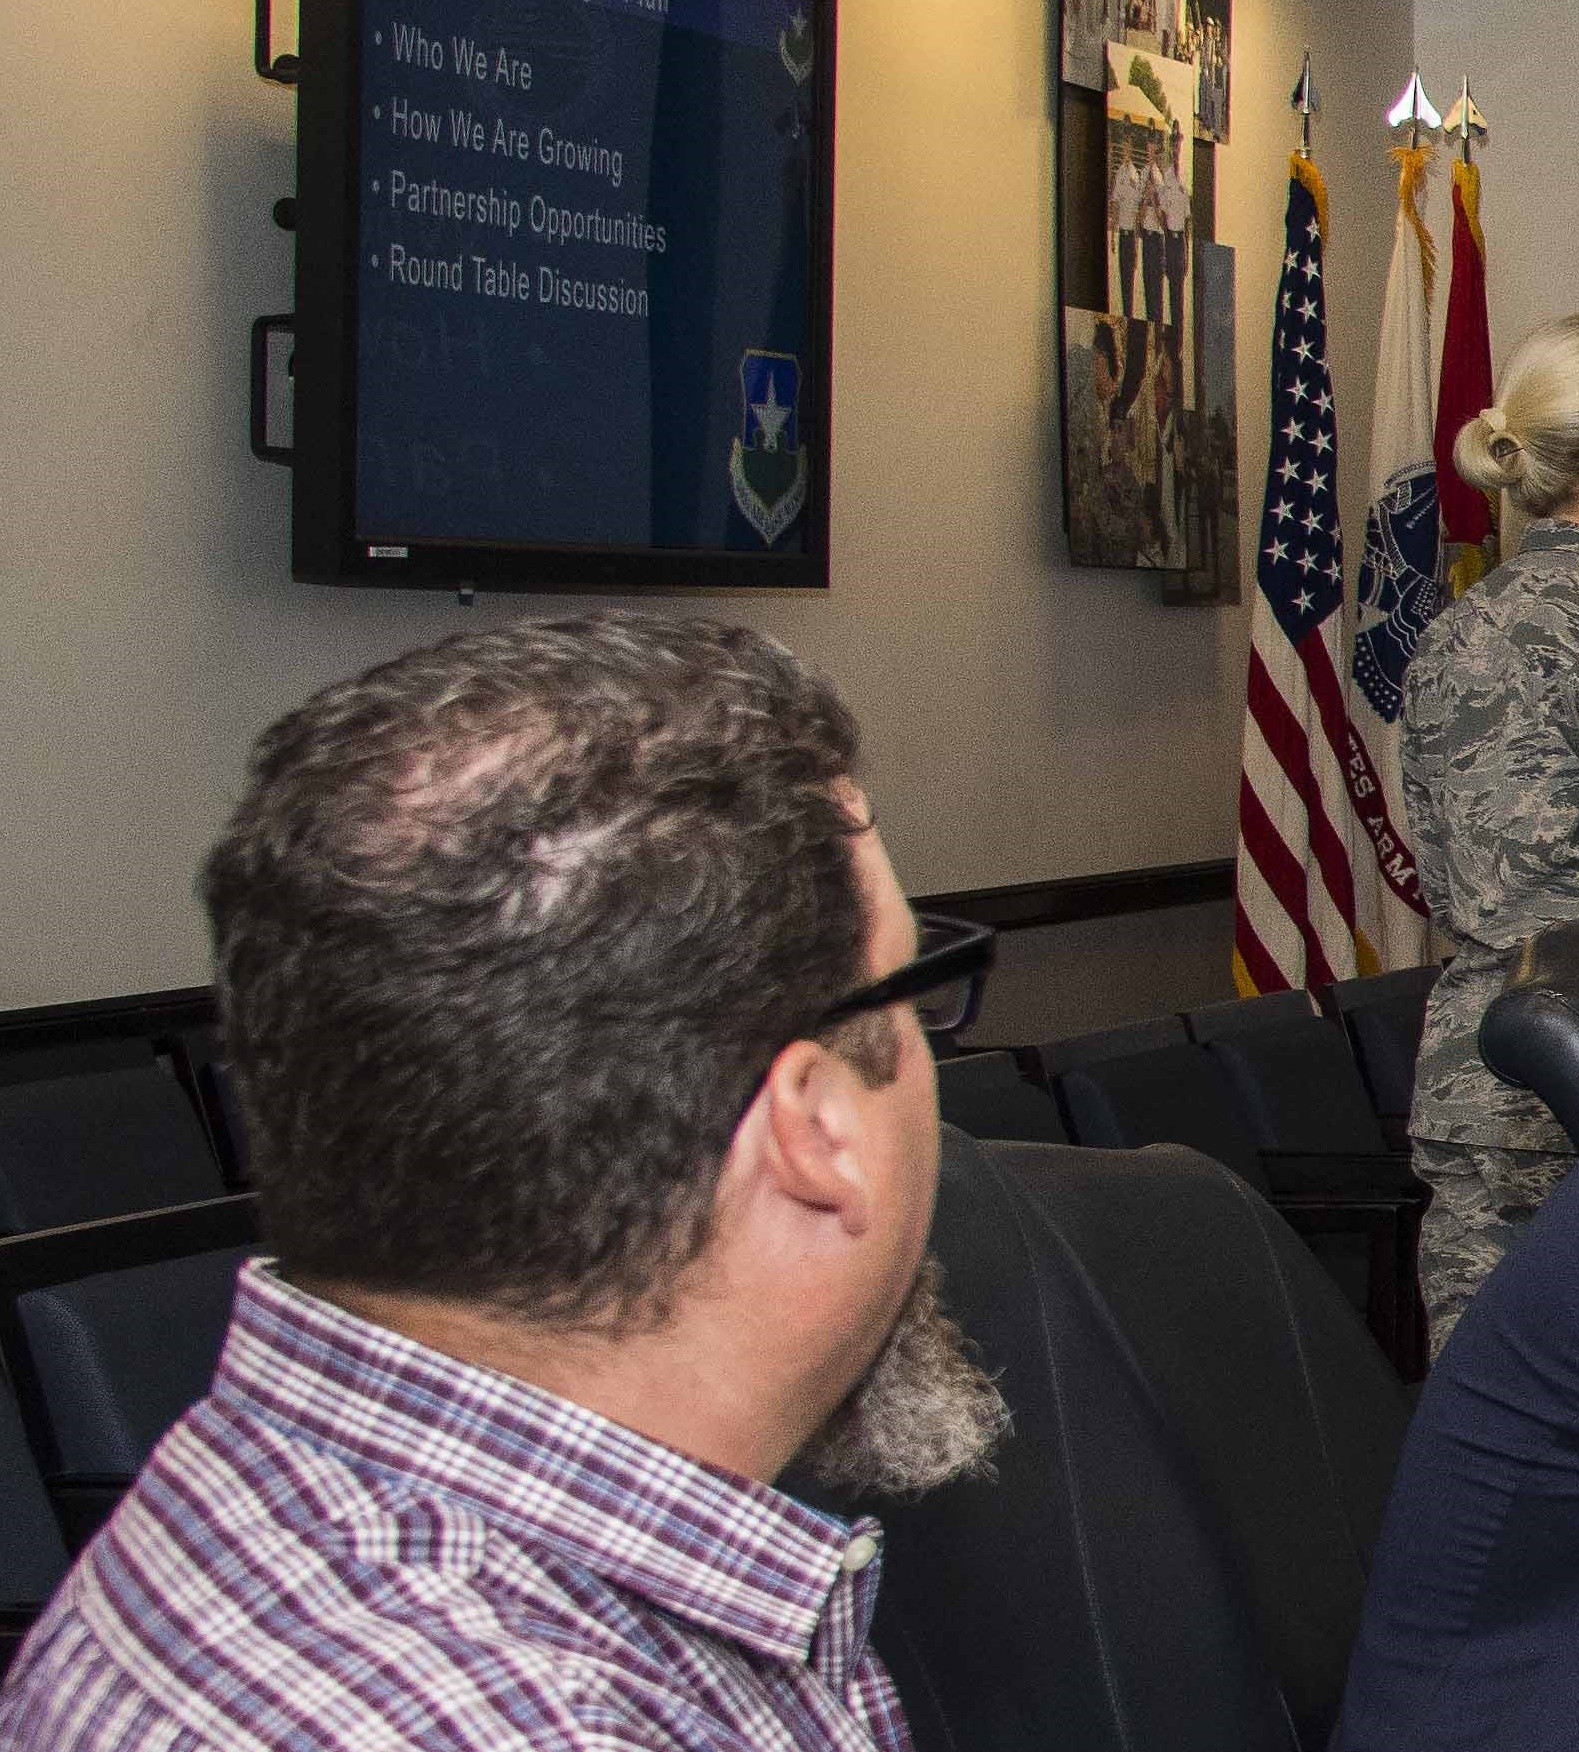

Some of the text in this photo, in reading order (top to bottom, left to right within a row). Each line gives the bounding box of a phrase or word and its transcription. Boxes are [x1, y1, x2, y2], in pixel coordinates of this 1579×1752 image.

[392, 21, 533, 91] Who We Are
[391, 97, 623, 188] How We Are Growing
[391, 170, 667, 254] Partnership Opportunities
[390, 243, 650, 318] Round Table Discussion
